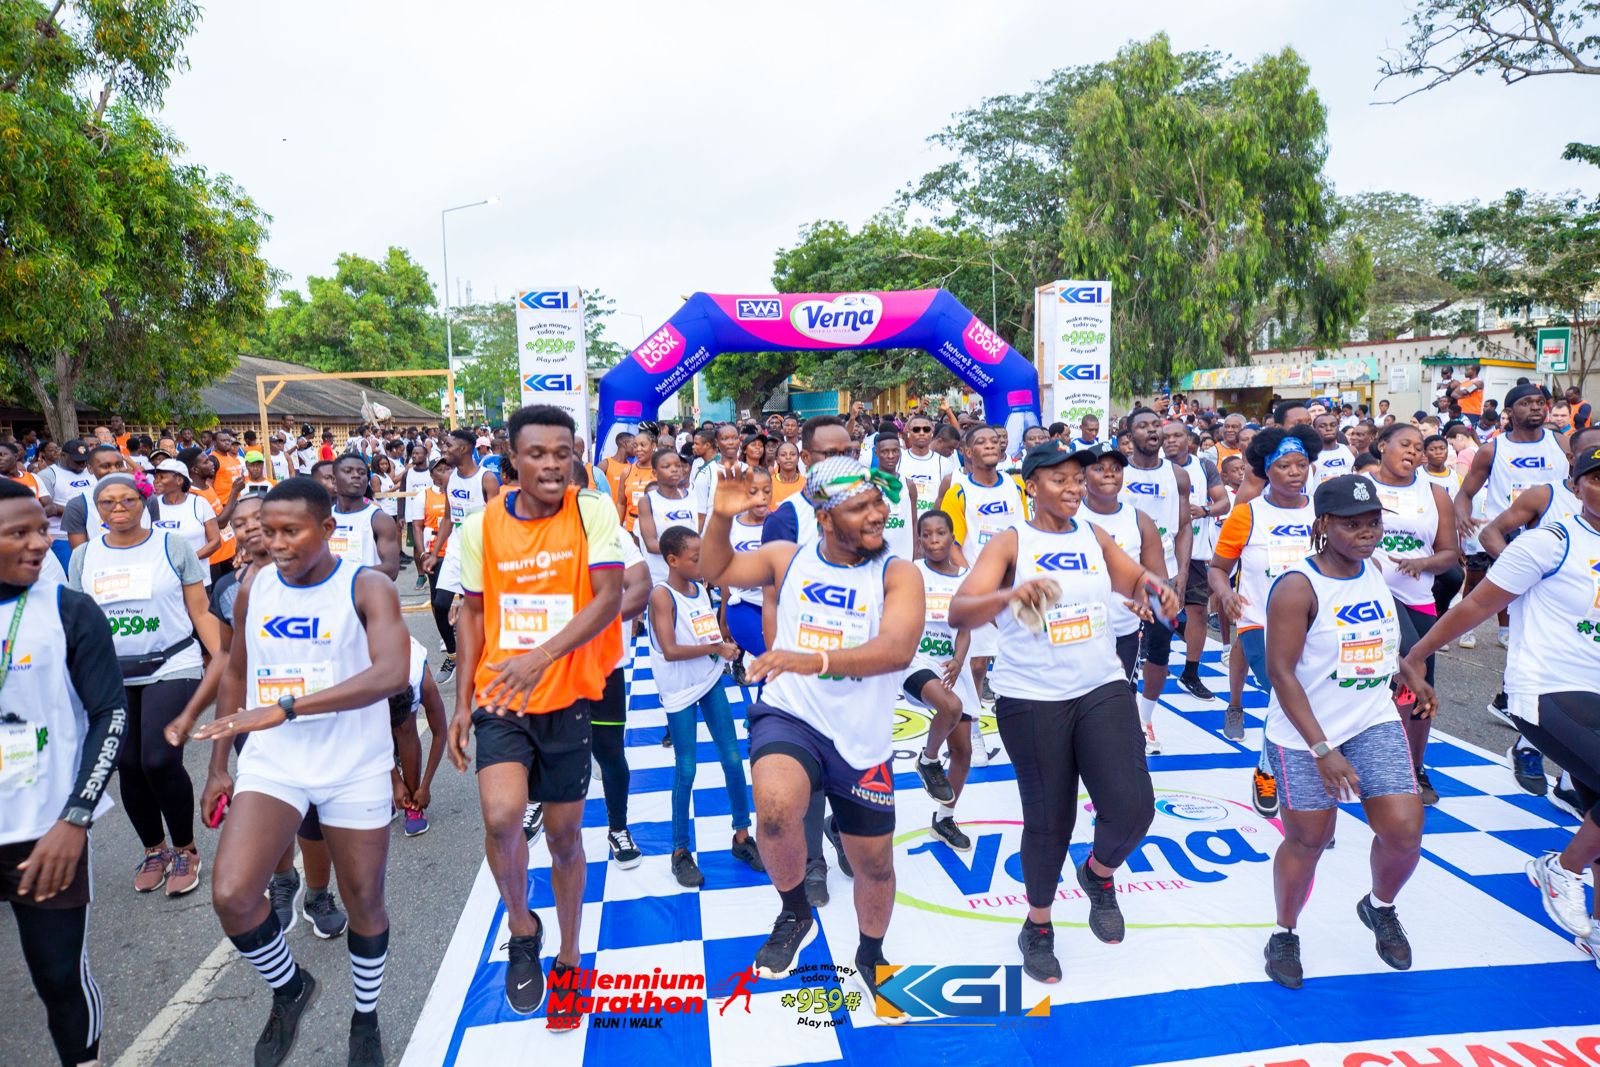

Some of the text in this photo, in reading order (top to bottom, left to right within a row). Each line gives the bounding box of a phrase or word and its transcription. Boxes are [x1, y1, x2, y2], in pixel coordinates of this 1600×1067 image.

[519, 291, 569, 309] KGI
[1058, 287, 1102, 303] KGI
[802, 305, 873, 331] Verna
[1065, 315, 1103, 325] make money
[529, 322, 572, 332] make money
[973, 320, 1005, 348] NEW
[637, 327, 671, 358] NEW
[967, 328, 1002, 358] LOOK
[536, 355, 568, 364] play now!
[644, 336, 680, 368] LOOK
[1070, 347, 1084, 356] play
[654, 345, 707, 393] Nature's Finest
[937, 347, 988, 389] MINERAL WATER
[943, 340, 994, 385] Nature's Finest
[661, 351, 711, 397] MINERAL WATER
[1057, 364, 1101, 380] KGI
[523, 374, 573, 391] KGI
[1064, 392, 1102, 401] make money
[1323, 458, 1345, 468] KGI
[1509, 457, 1545, 468] KGI
[69, 480, 90, 488] KGI
[1125, 481, 1159, 495] KGI
[451, 489, 470, 499] KGI
[665, 510, 693, 520] KGI
[977, 501, 1008, 515] KGI
[154, 520, 181, 529] KGI
[735, 540, 762, 552] KG
[550, 550, 574, 562] BANK
[1034, 553, 1088, 571] KGI
[800, 581, 856, 610] KGI
[126, 607, 143, 615] Now!
[1334, 600, 1385, 626] KGI
[260, 616, 320, 639] KGI
[8, 664, 32, 672] ROUP
[80, 707, 127, 801] THE GRANGE
[851, 785, 895, 807] Reebo
